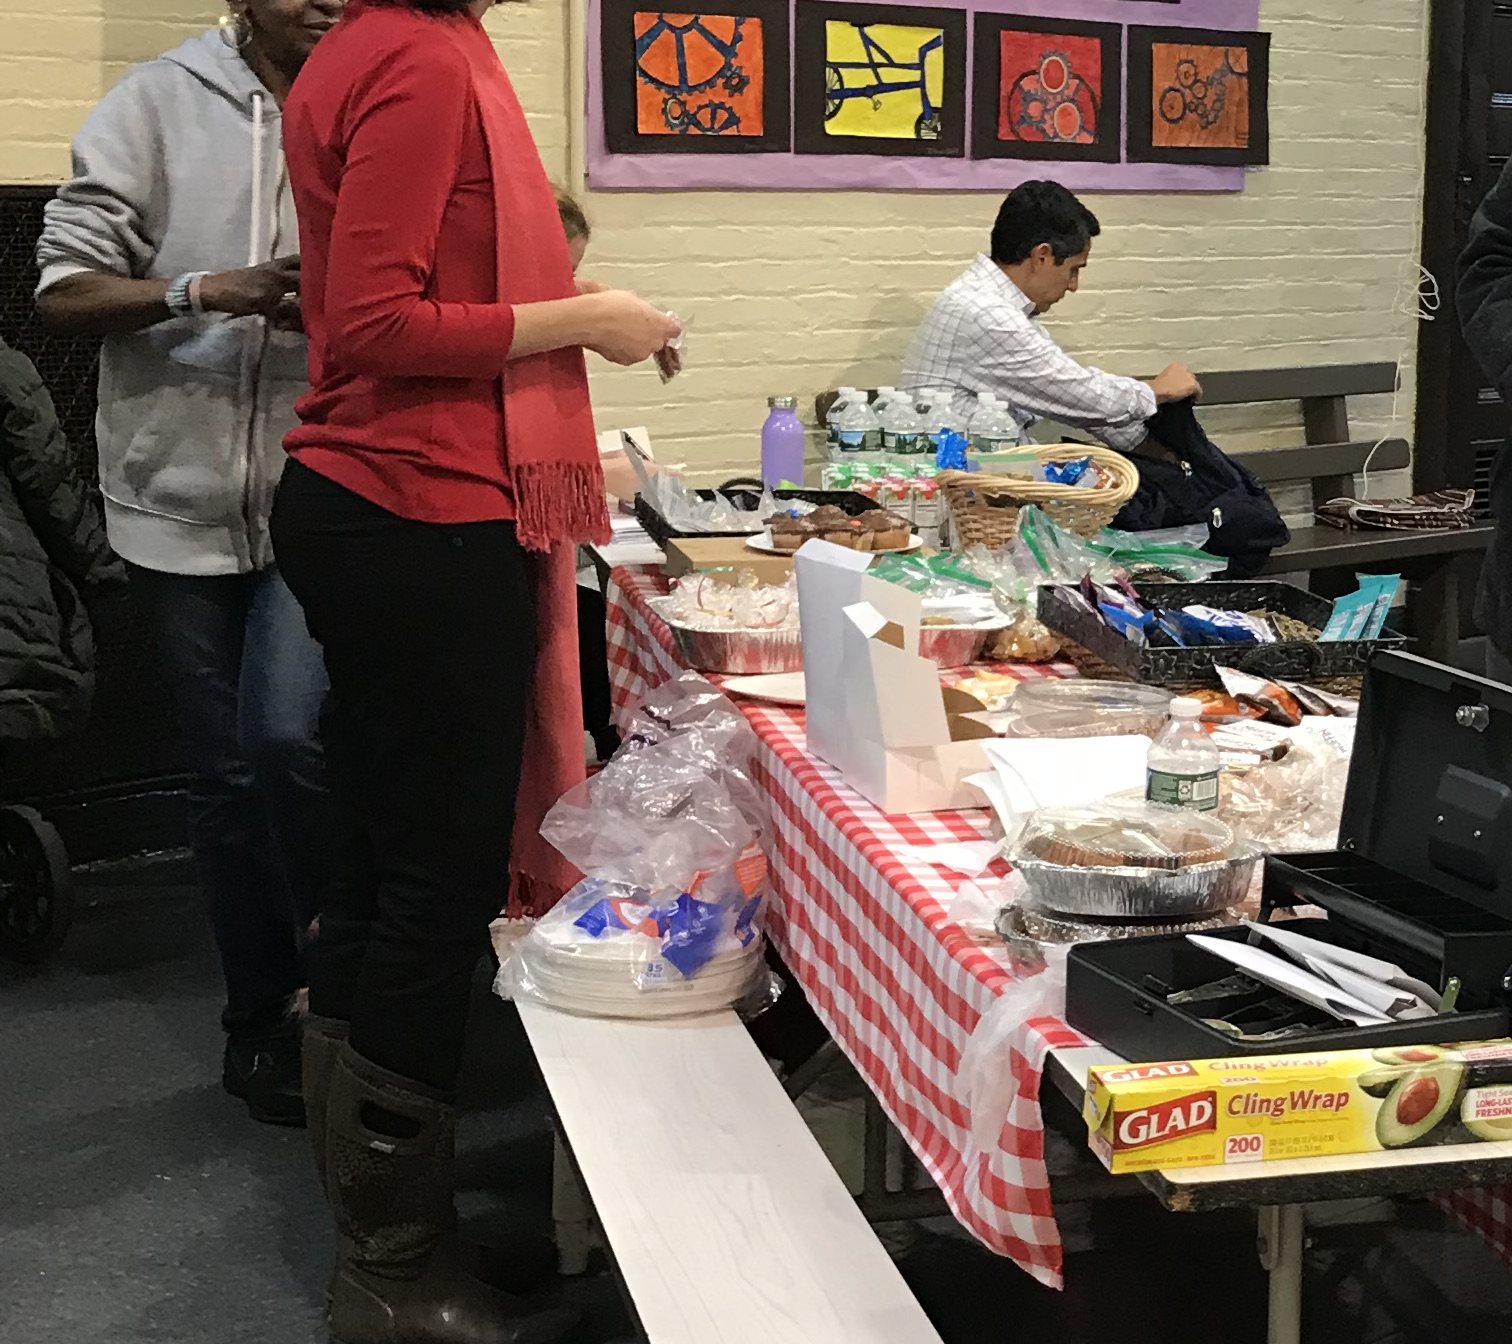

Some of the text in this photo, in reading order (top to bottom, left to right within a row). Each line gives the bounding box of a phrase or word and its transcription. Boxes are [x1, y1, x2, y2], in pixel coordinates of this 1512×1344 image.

[1101, 1063, 1191, 1083] GLAD
[1208, 1058, 1329, 1072] Cling Wrap
[1226, 1089, 1350, 1118] Cling Wrap
[1118, 1100, 1214, 1145] GLAD
[1227, 1136, 1262, 1154] 200
